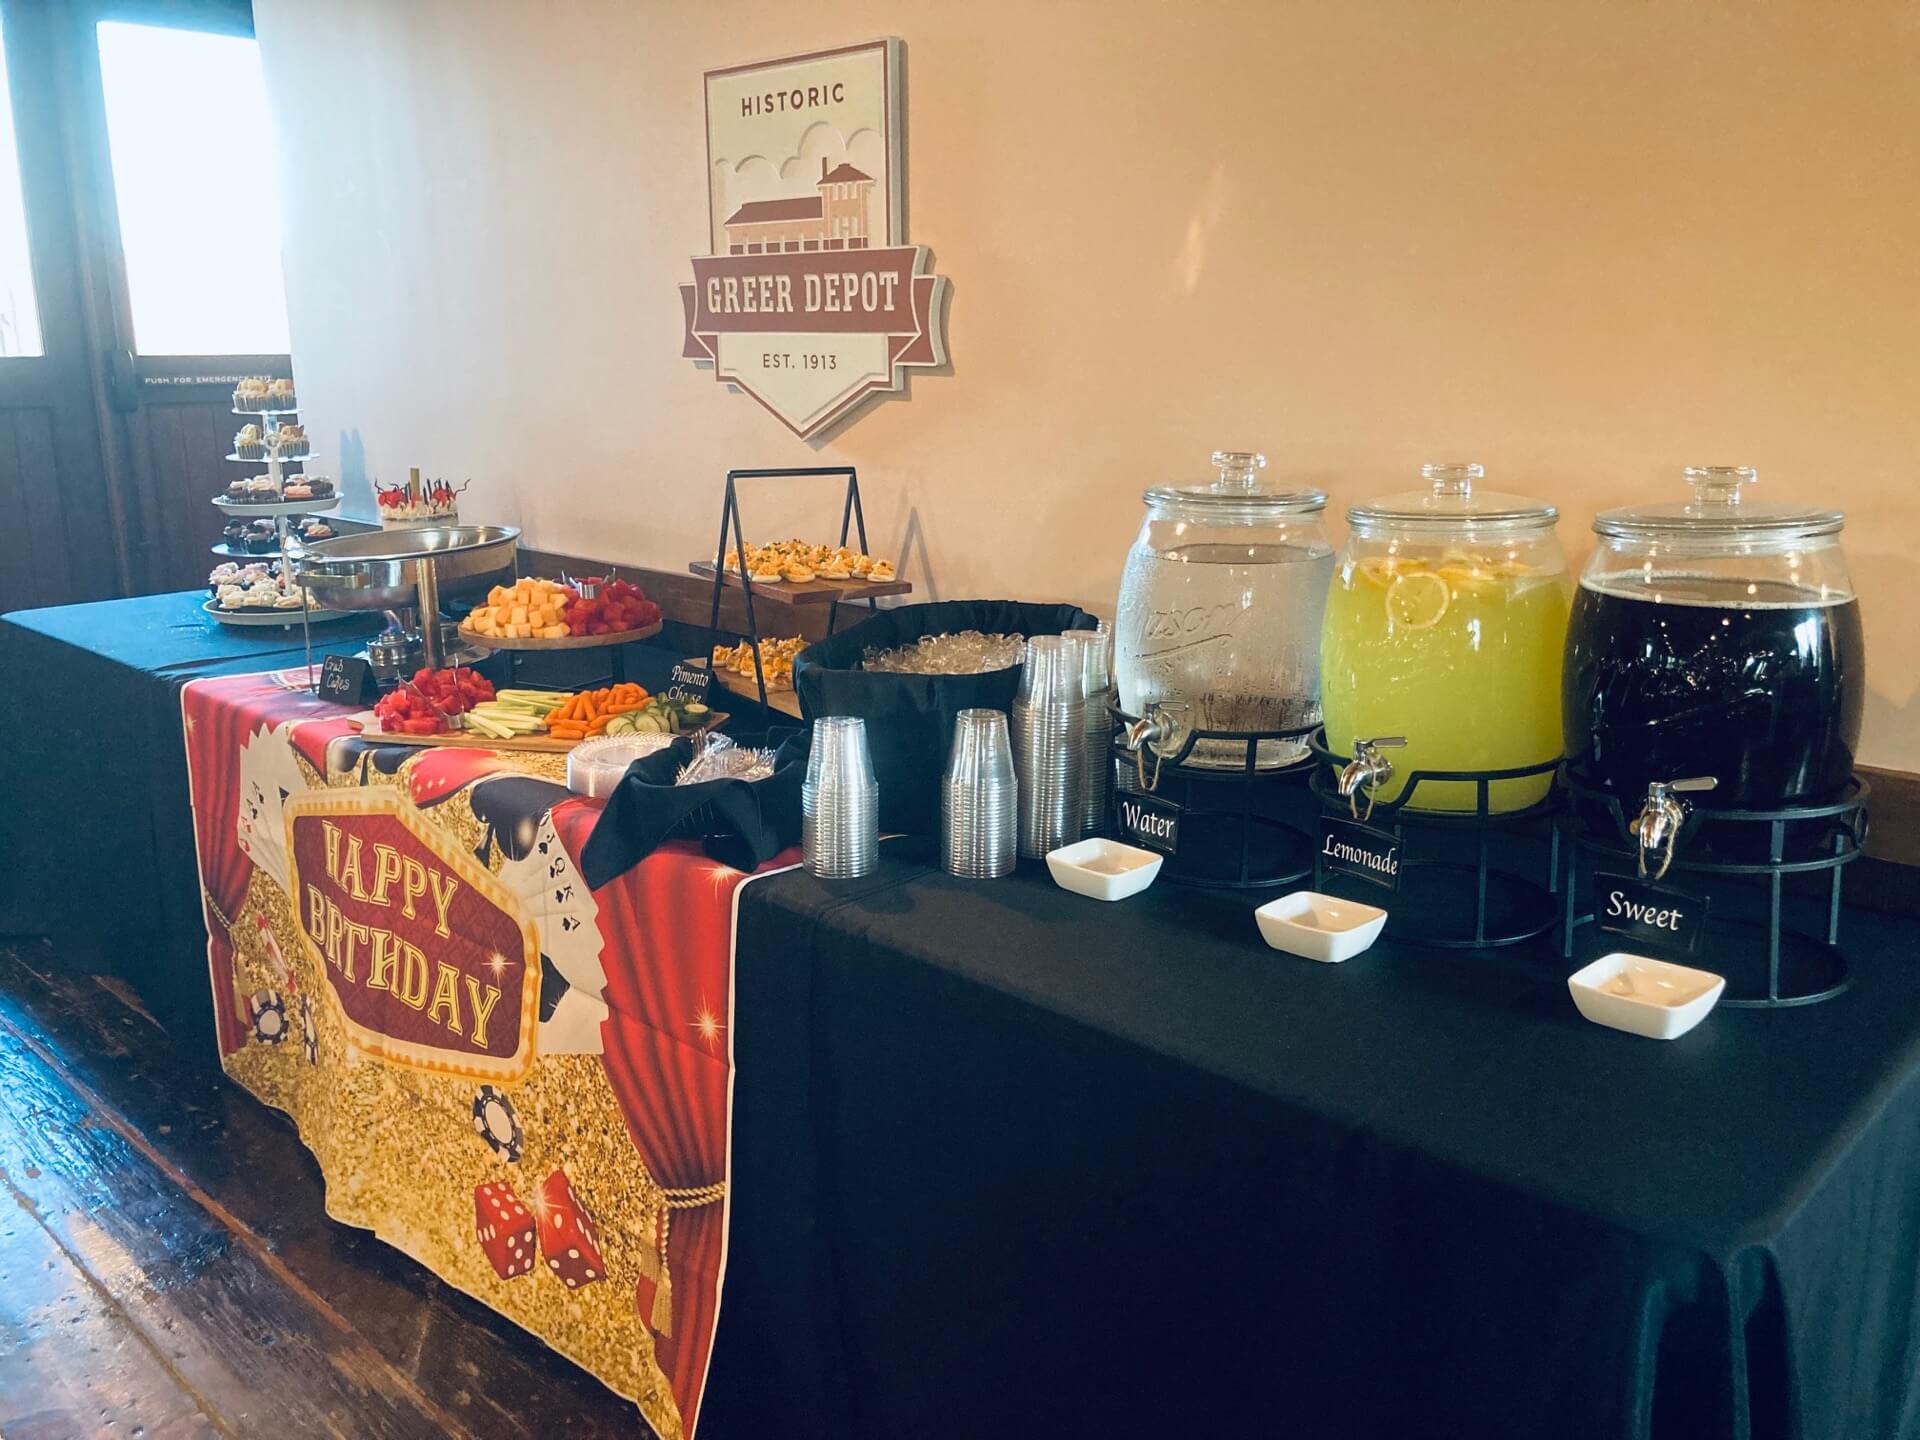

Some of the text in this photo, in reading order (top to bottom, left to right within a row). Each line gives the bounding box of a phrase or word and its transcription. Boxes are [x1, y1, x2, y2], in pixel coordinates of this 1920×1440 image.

[741, 82, 846, 118] HISTORIC
[706, 271, 899, 314] GREER DEPOT
[144, 377, 170, 385] PUSH
[173, 376, 192, 384] FOR
[762, 353, 838, 370] EST. 1913
[671, 665, 709, 687] Pimento
[1122, 800, 1176, 838] Water
[1321, 834, 1399, 876] Lemonade
[321, 819, 459, 940] HAPPY
[1606, 890, 1684, 931] Sweet
[306, 883, 502, 1049] BRTHDAY
